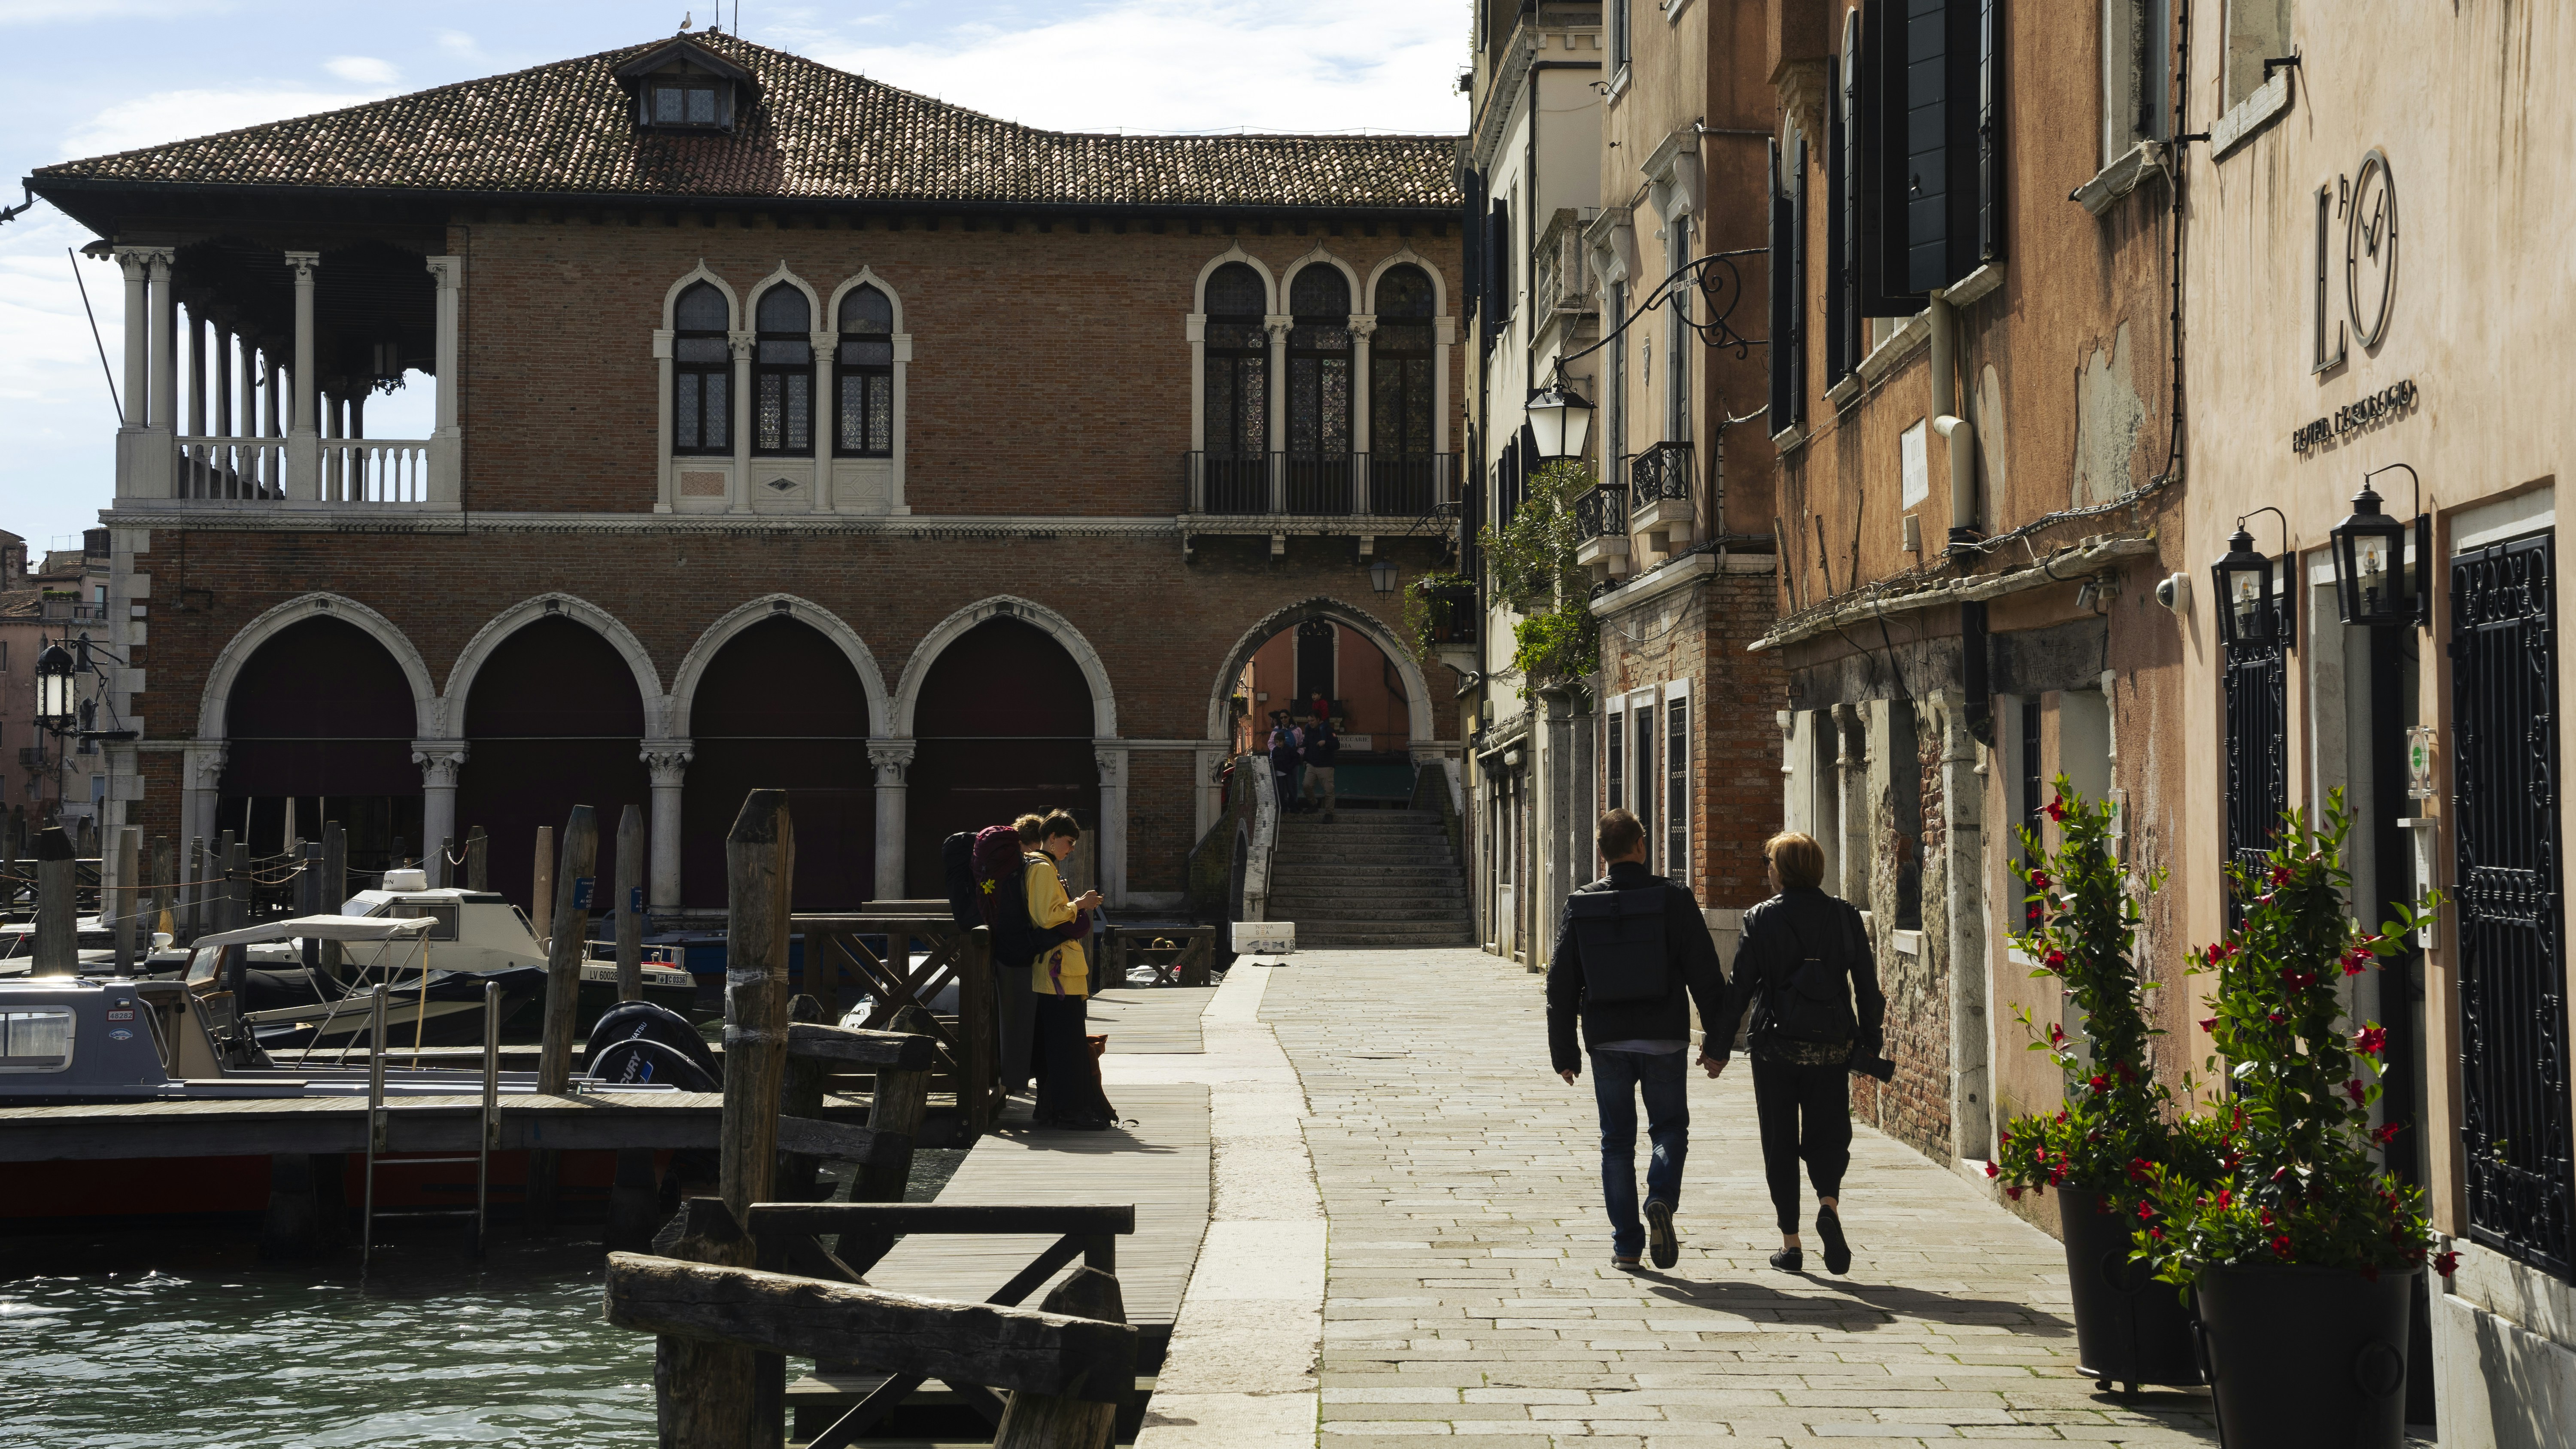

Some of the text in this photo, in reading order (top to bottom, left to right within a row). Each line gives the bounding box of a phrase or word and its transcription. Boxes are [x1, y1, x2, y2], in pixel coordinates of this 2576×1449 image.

[2293, 417, 2335, 453] HOTEL
[1911, 437, 1920, 462] RIVA
[589, 970, 598, 980] LV
[673, 976, 686, 984] 0336
[630, 1022, 647, 1040] HATSU
[620, 1050, 641, 1084] CURY
